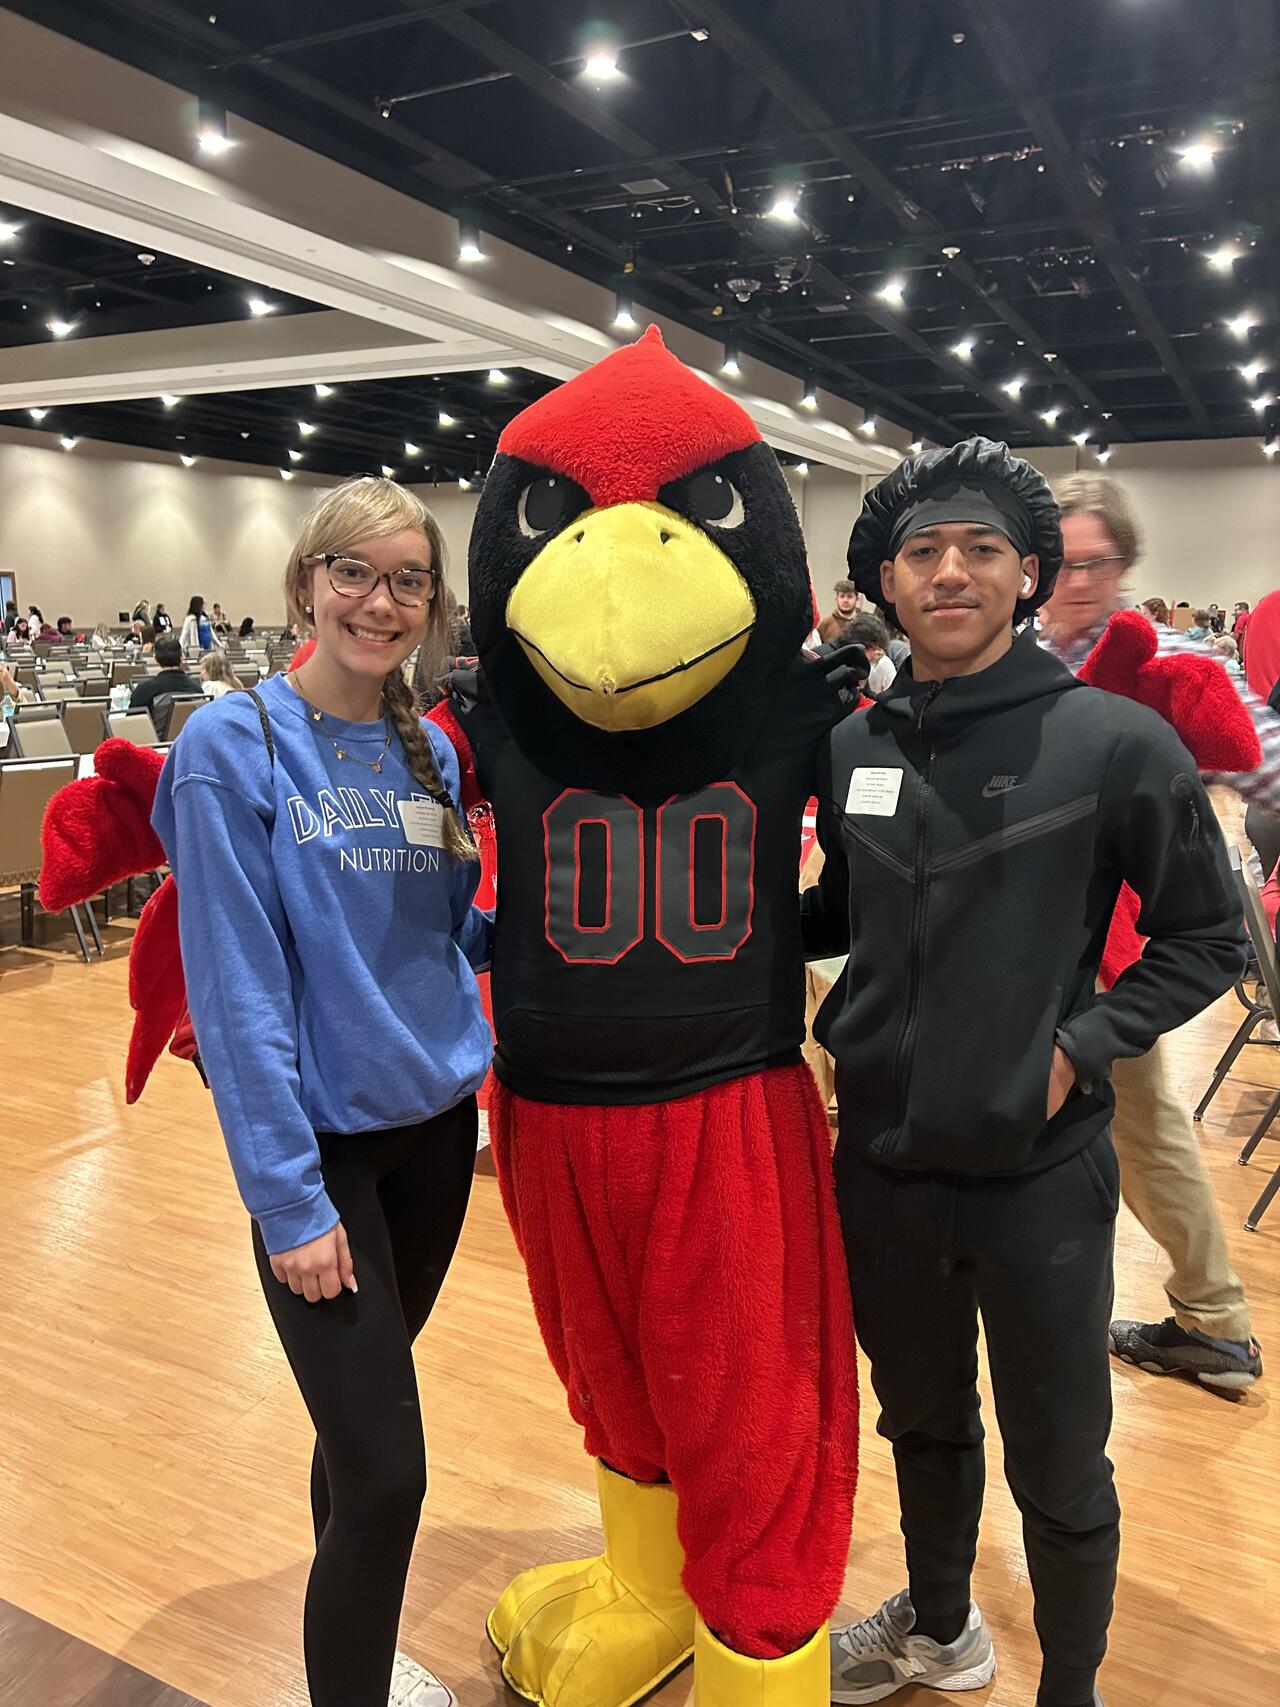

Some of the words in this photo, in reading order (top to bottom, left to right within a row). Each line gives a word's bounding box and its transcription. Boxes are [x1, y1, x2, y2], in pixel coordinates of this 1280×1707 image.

[989, 775, 1019, 788] NIKE
[287, 787, 400, 845] DAILY
[340, 847, 440, 873] NUTRITION
[542, 781, 758, 964] 00
